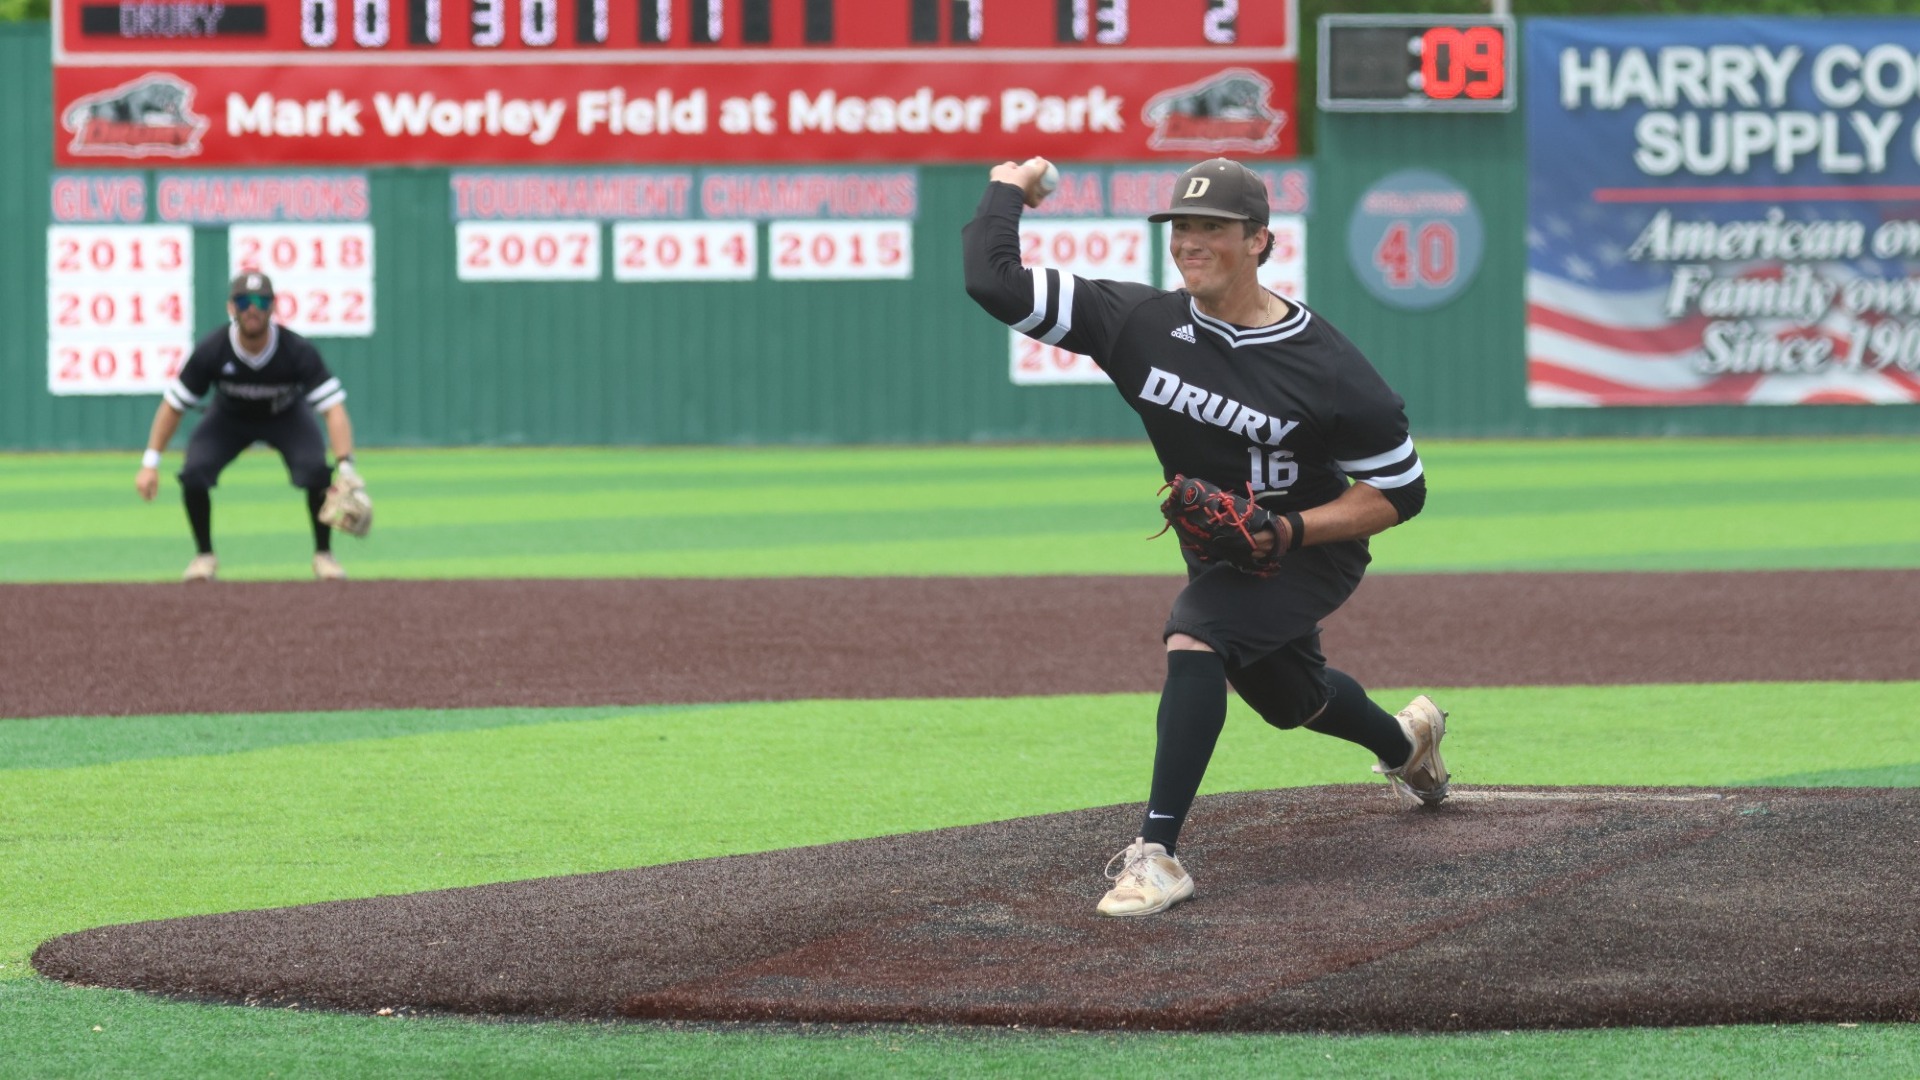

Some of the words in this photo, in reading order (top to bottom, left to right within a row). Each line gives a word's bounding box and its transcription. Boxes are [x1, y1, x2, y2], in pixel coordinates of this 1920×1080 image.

[119, 0, 225, 37] DRURY
[301, 0, 337, 47] 0
[353, 0, 390, 47] 0
[471, 0, 504, 46] 3
[520, 0, 557, 46] 0
[1072, 0, 1128, 44] 13
[1203, 0, 1239, 44] 2
[1559, 44, 1803, 111] HARRY
[1812, 43, 1920, 108] CO
[226, 90, 364, 137] Mark
[373, 90, 566, 145] Worley
[577, 87, 707, 135] Field
[719, 93, 777, 135] at
[788, 87, 990, 134] Meador
[1001, 86, 1126, 133] Park
[1633, 110, 1902, 176] SUPPLY
[51, 176, 147, 222] GLVC
[156, 175, 370, 222] CHAMPIONS
[451, 173, 693, 218] TOURNAMENT
[701, 173, 915, 218] CHAMPIONS
[1023, 172, 1103, 216] AA
[1182, 177, 1211, 200] D
[465, 233, 591, 267] 2007
[621, 233, 748, 268] 2014
[778, 232, 902, 267] 2015
[1020, 231, 1142, 266] 2007
[1628, 206, 1866, 261] American
[56, 236, 184, 272] 2013
[239, 236, 366, 272] 2018
[1373, 220, 1458, 288] 40
[56, 291, 184, 327] 2014
[273, 291, 366, 324] 022
[1665, 264, 1836, 328] Family
[1844, 276, 1920, 315] ow
[1019, 337, 1102, 371] 20
[1171, 330, 1196, 344] adidas
[1697, 320, 1835, 374] Since
[56, 347, 184, 381] 2017
[1138, 366, 1300, 446] DRURY
[1247, 446, 1299, 491] 16
